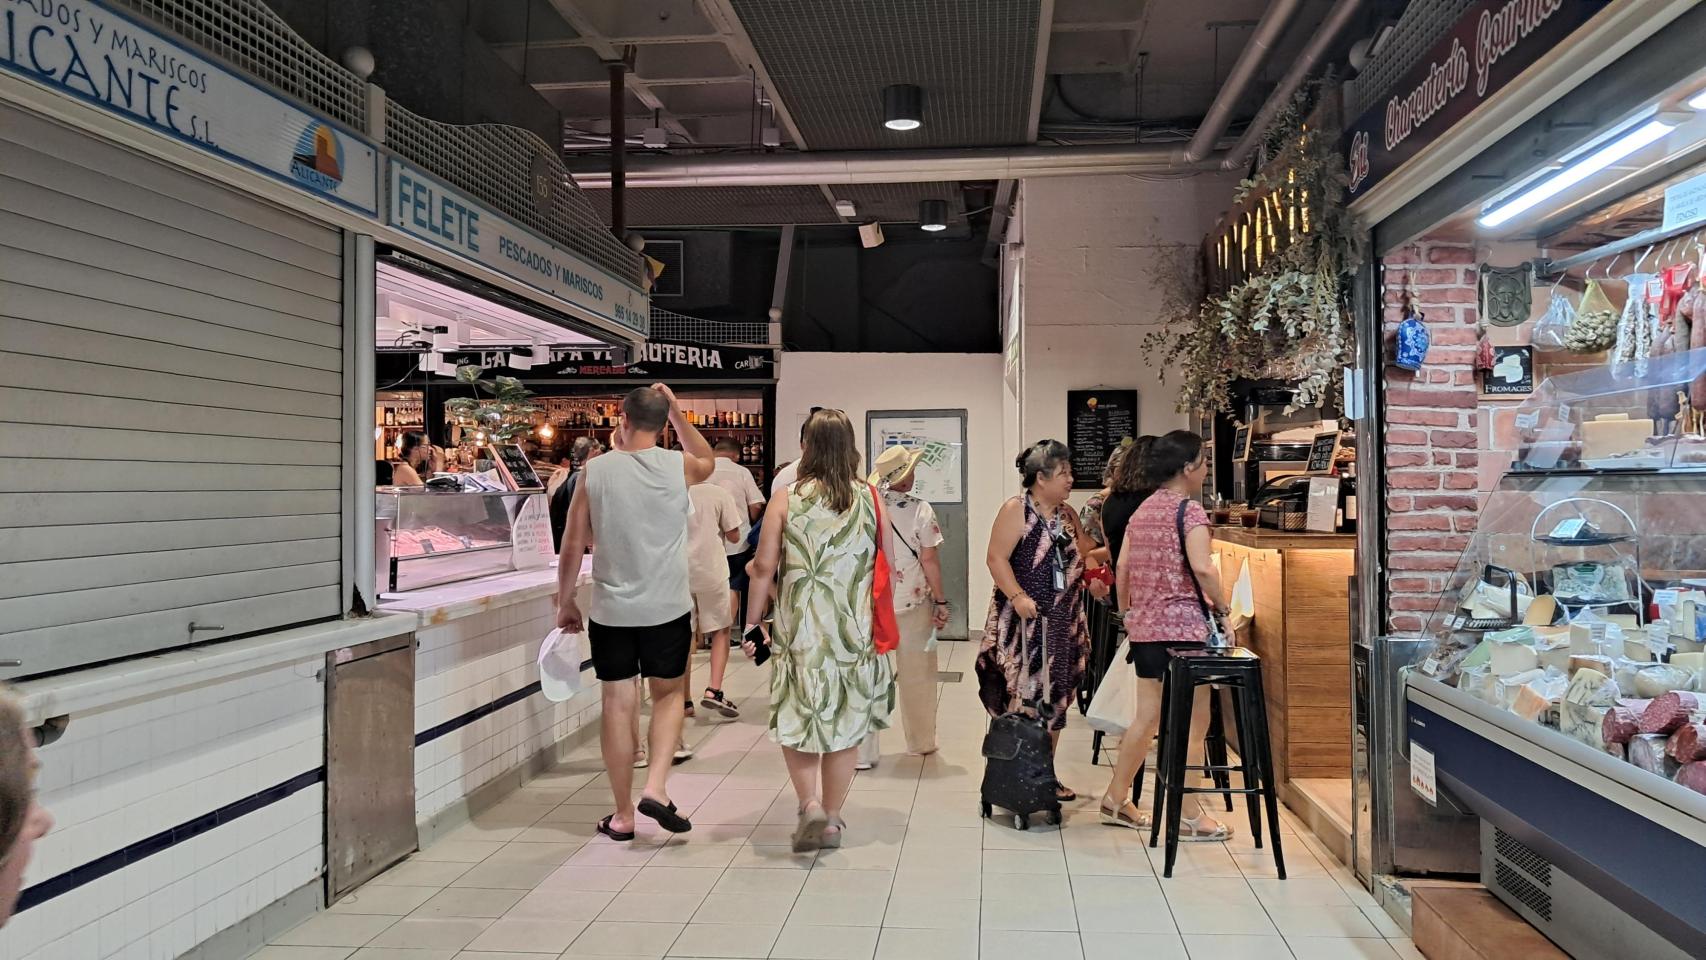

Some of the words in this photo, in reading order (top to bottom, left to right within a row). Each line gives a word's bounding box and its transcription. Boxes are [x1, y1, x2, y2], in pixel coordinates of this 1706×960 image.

[89, 18, 104, 45] Y
[111, 29, 208, 94] MARISCOS
[290, 160, 338, 193] ALICANTE
[399, 174, 480, 253] FELETE
[499, 235, 553, 278] PESCADOS
[554, 263, 561, 280] Y
[562, 269, 604, 301] MARISCOS
[481, 351, 507, 370] LA
[1484, 384, 1533, 393] FROMAGES
